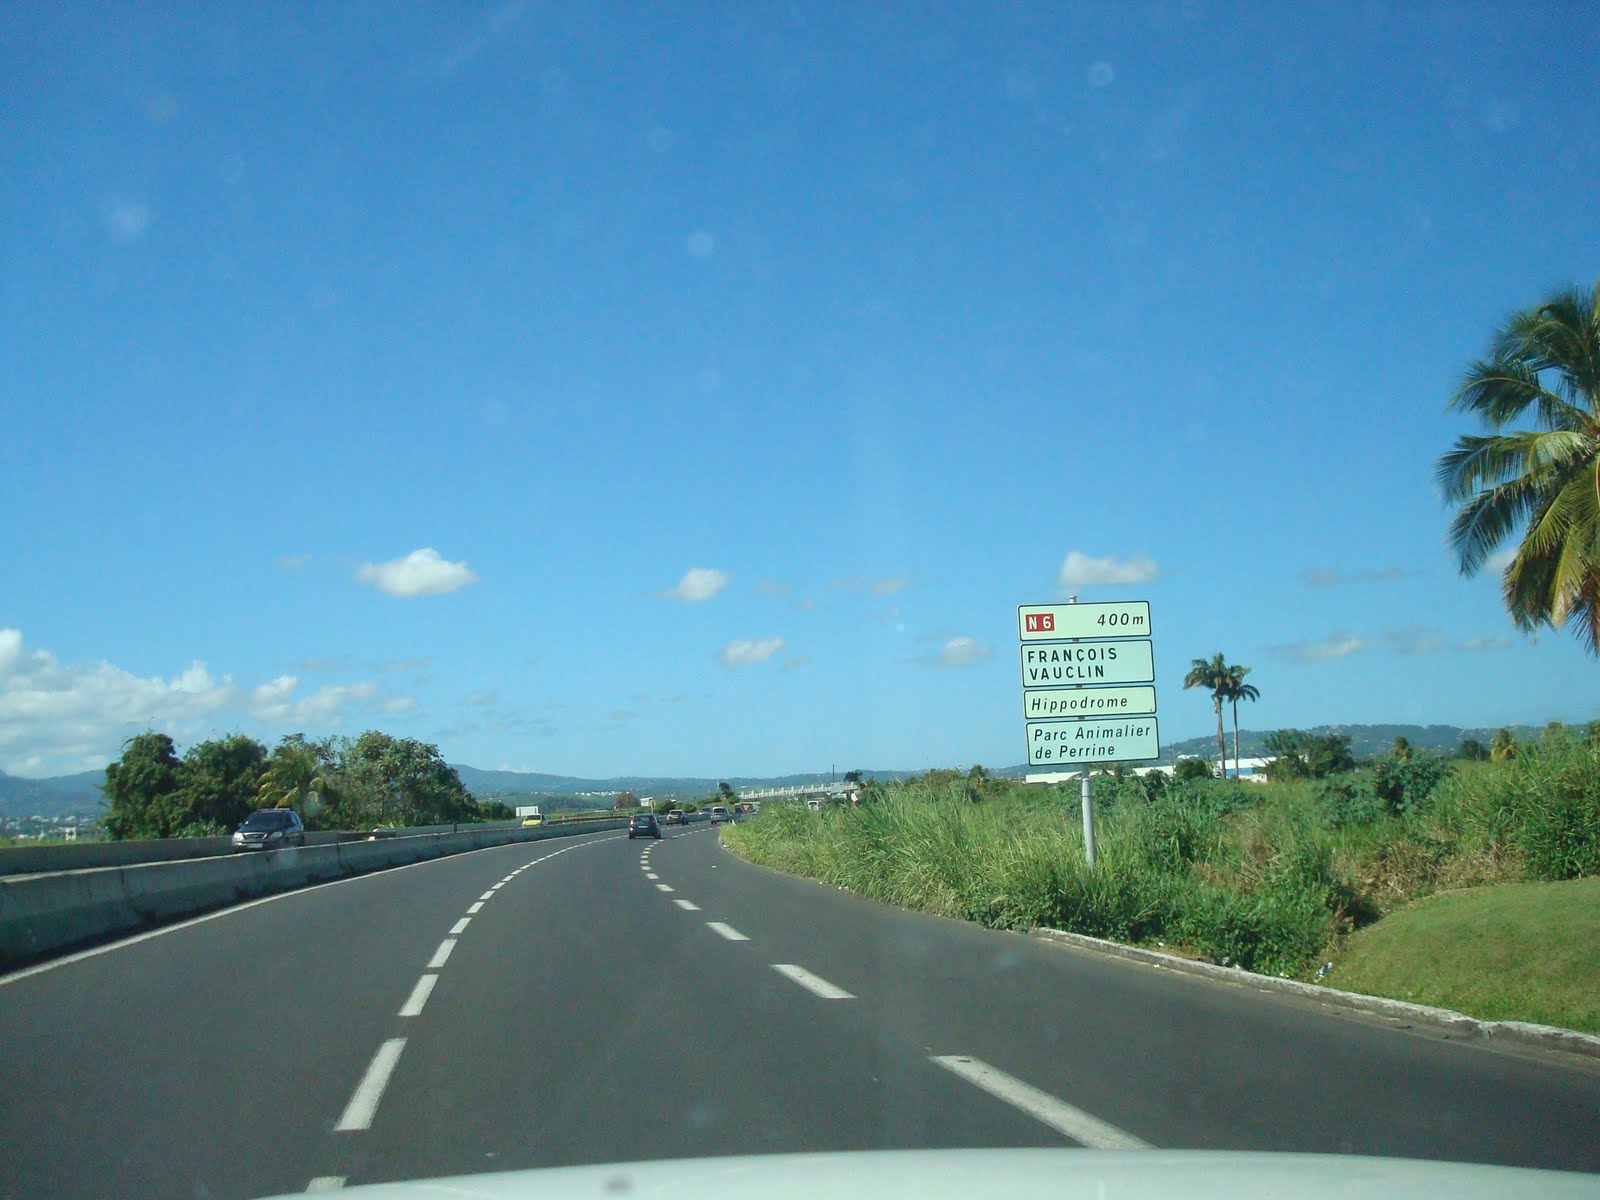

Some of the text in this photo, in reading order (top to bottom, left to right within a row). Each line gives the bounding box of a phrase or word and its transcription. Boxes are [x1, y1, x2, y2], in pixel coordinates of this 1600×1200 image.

[1027, 647, 1117, 663] FRANÇOIS
[1029, 665, 1104, 680] VAUCLIN
[1031, 696, 1128, 713] Hippodrome
[1034, 724, 1151, 741] Parc Animalier
[1035, 743, 1115, 759] de Perrine
